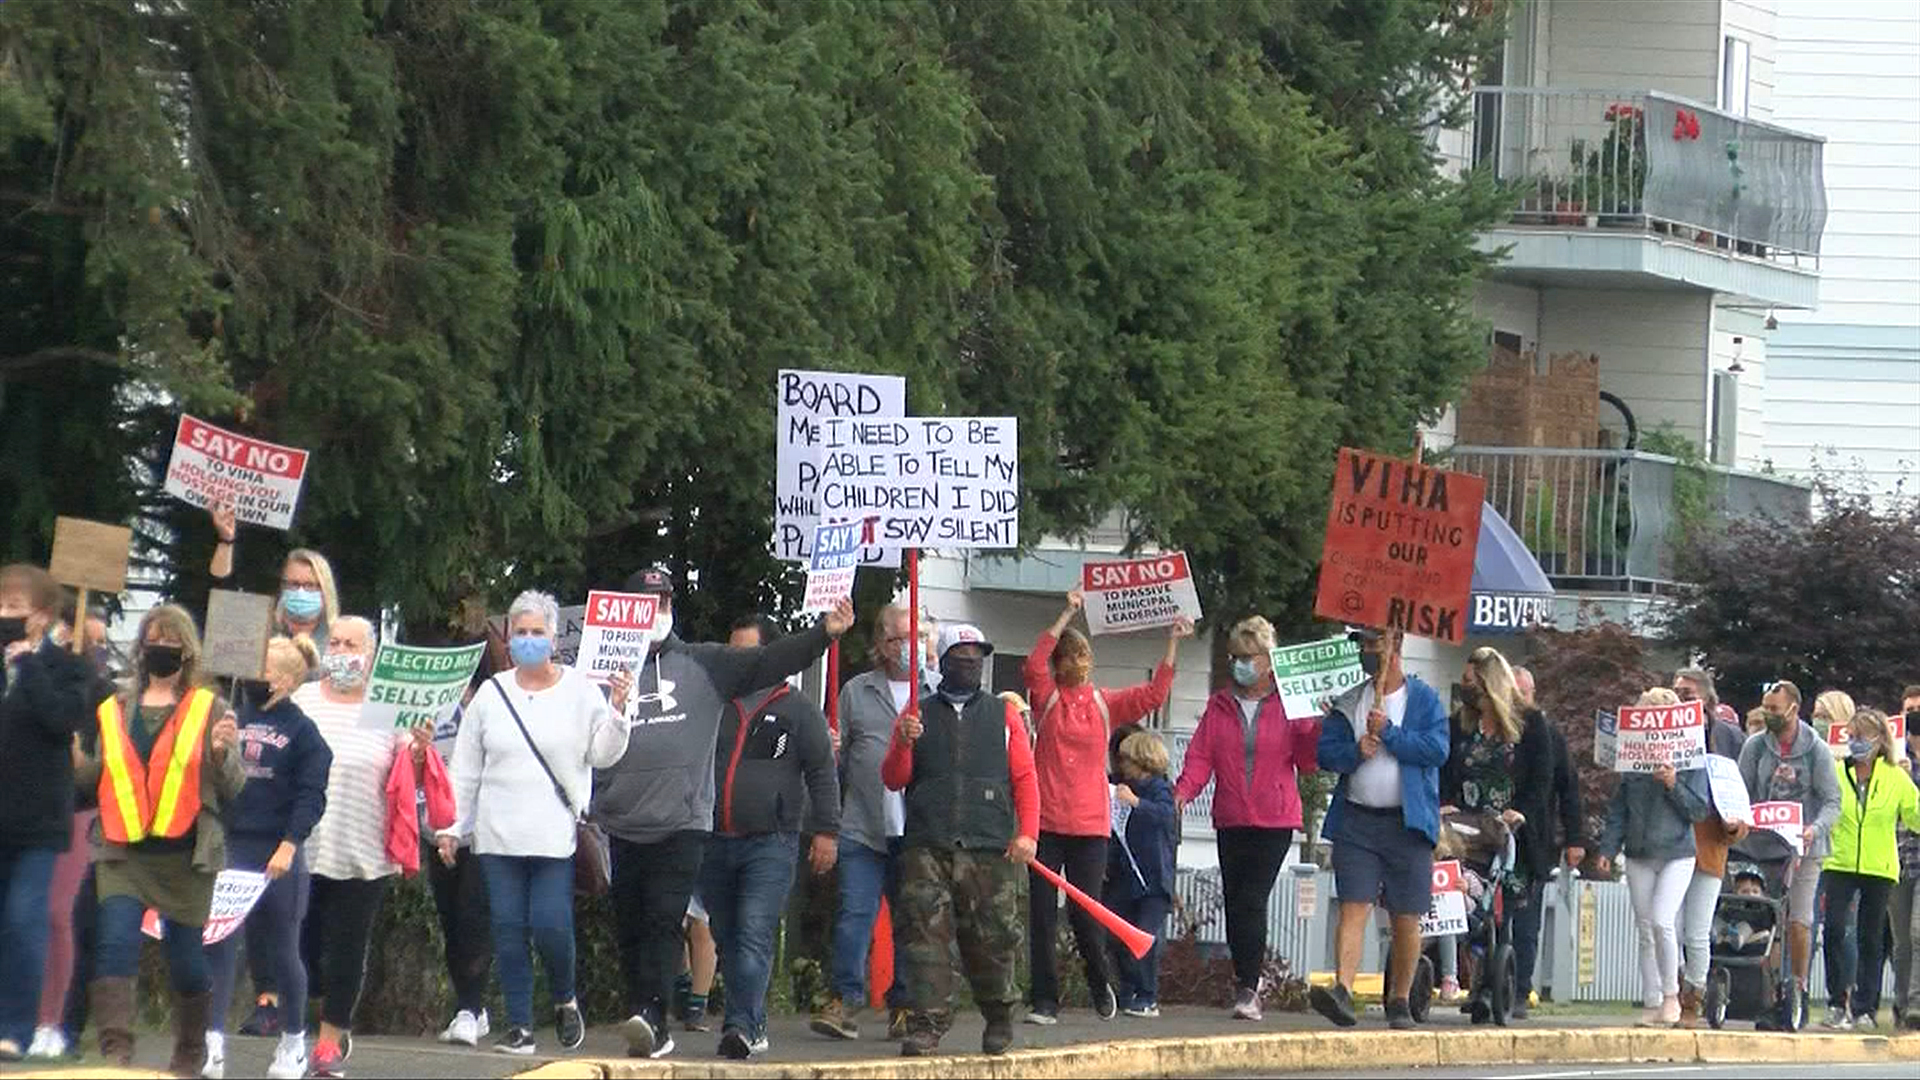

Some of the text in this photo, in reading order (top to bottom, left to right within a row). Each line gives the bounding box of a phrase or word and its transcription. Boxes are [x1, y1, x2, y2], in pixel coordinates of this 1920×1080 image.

[781, 373, 881, 415] BOARD
[826, 420, 1001, 448] I NEED TO BE
[190, 427, 290, 472] SAY NO
[206, 457, 264, 484] TO VIHA
[822, 450, 1015, 482] ABLE TO TELL MY
[180, 459, 280, 500] HOLDING YOU
[1351, 455, 1448, 511] VIHA
[170, 470, 291, 514] HOSTAGE IN OUR
[824, 482, 1018, 513] CHILDREN I DID
[884, 516, 934, 543] STAY
[938, 517, 1015, 545] SILENT
[1337, 501, 1462, 546] IS PUTTING
[819, 528, 848, 552] SAY
[1388, 542, 1428, 566] OUR
[1092, 561, 1175, 586] SAY NO
[1104, 584, 1172, 601] TO PASSIVE
[1107, 595, 1174, 612] MUNICIPAL
[596, 598, 652, 624] SAY NO
[1105, 605, 1180, 624] LEADERSHIP
[1387, 597, 1458, 641] RISK
[601, 630, 614, 641] TO
[380, 650, 452, 670] ELECTED
[1275, 645, 1335, 666] ELECTED
[369, 685, 436, 707] SELLS
[1281, 675, 1334, 696] SELLS
[1629, 711, 1668, 728] SAY
[1671, 708, 1696, 726] NO
[1624, 740, 1697, 751] HOLDING YOU
[1645, 730, 1685, 741] TO VIHA
[1618, 750, 1670, 760] HOSTAGE
[1760, 807, 1791, 822] NO
[1437, 919, 1463, 931] SITE
